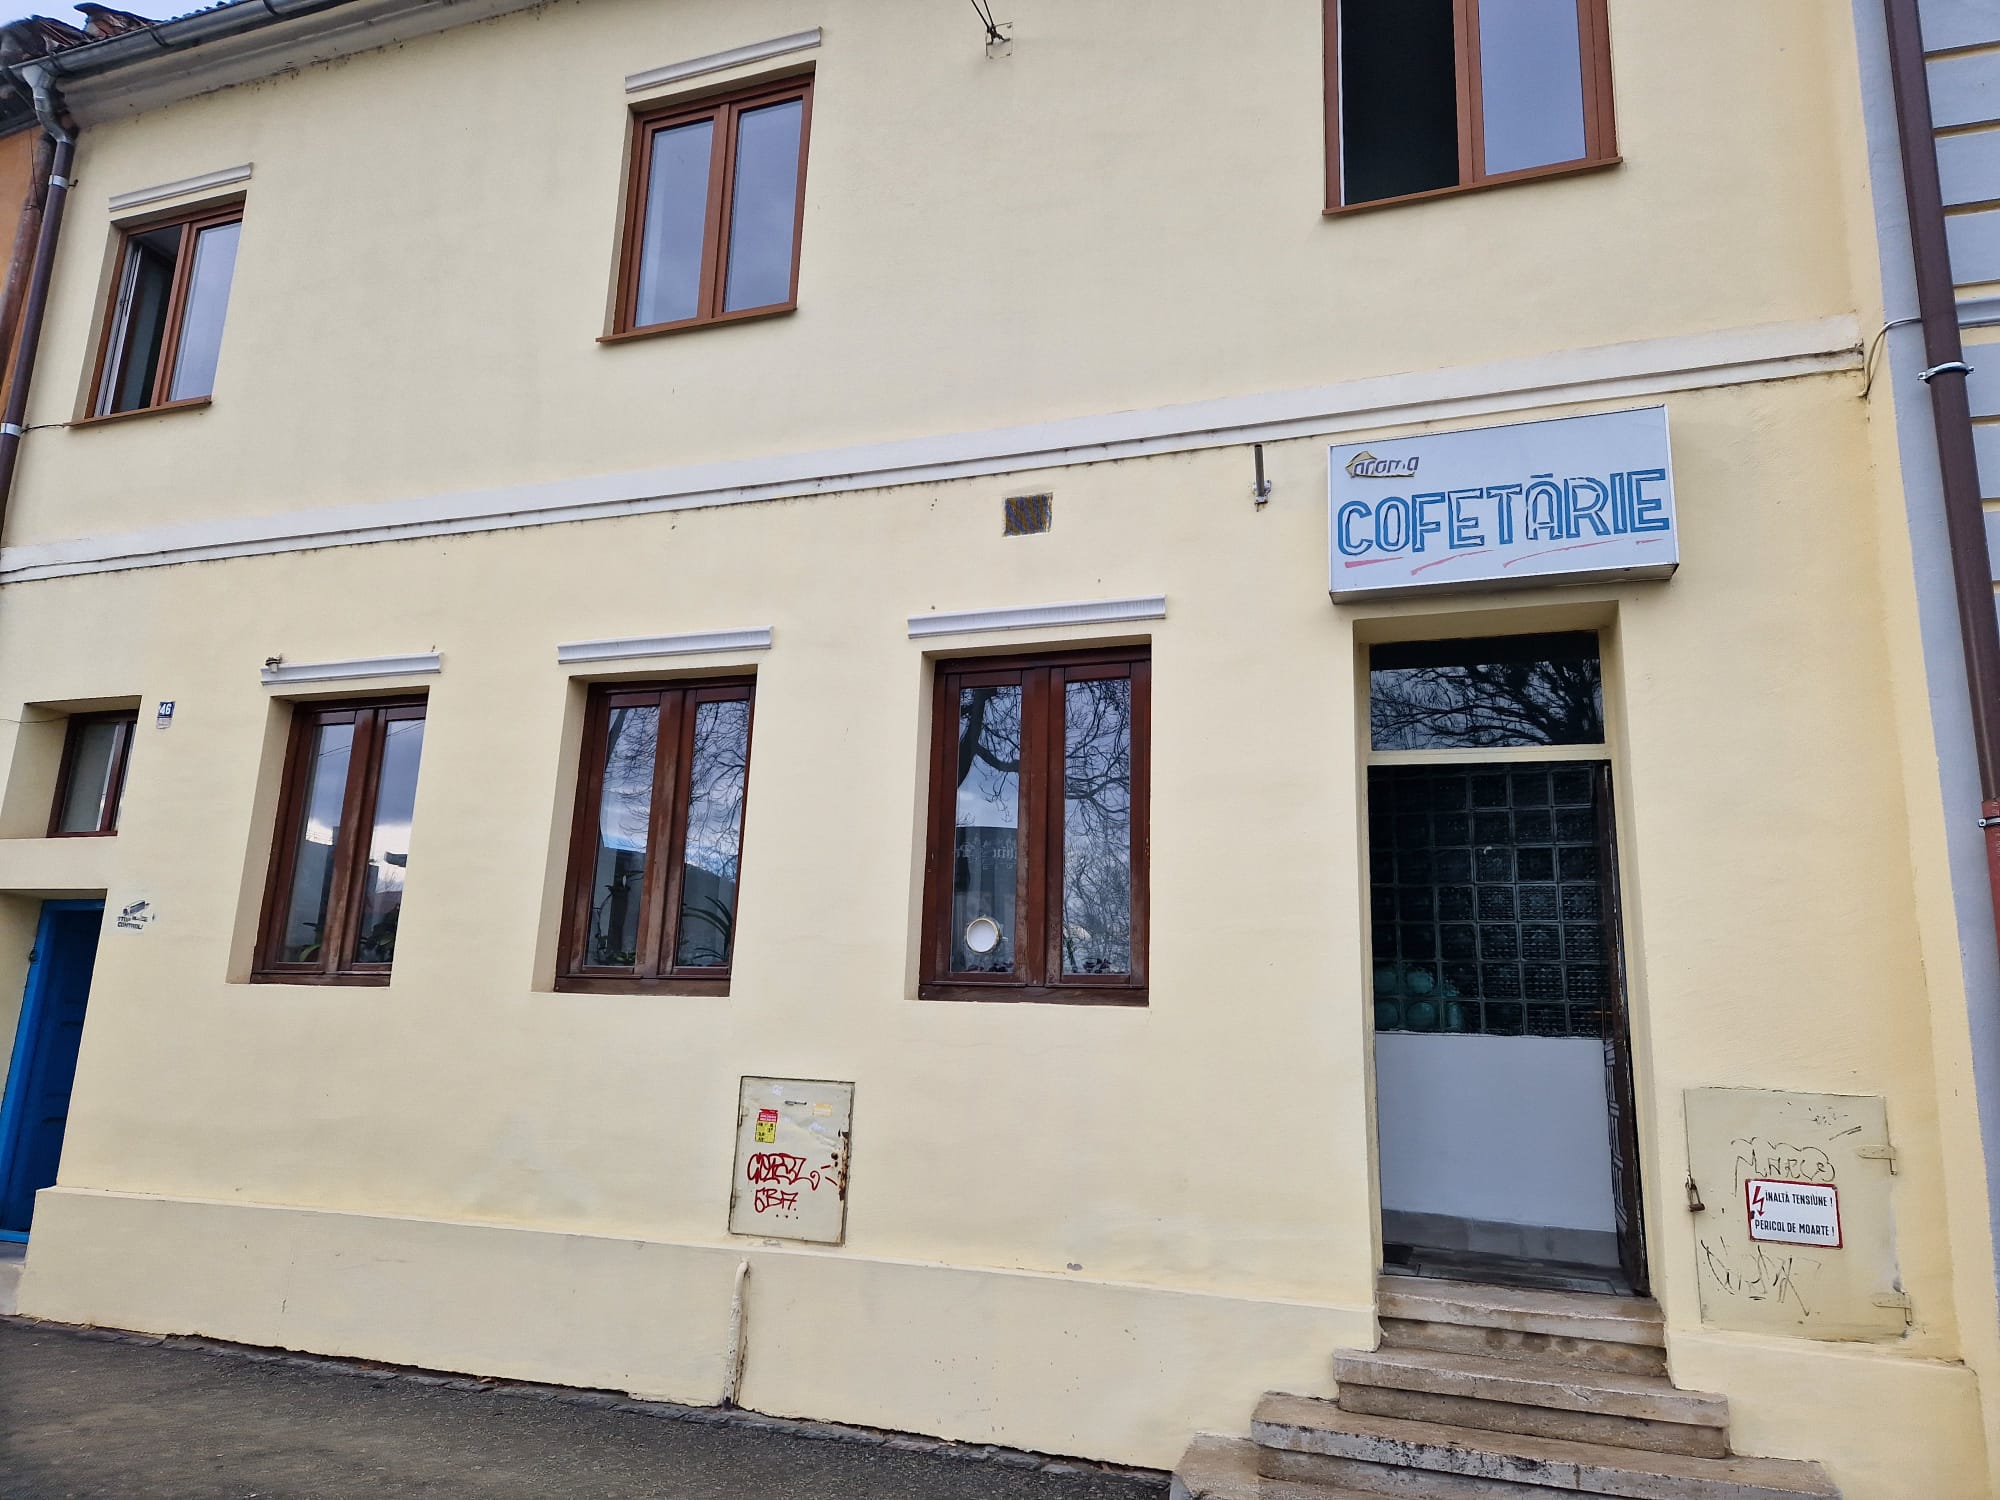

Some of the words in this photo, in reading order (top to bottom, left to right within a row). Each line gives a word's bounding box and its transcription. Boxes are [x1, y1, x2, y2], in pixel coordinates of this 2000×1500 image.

[160, 703, 172, 715] 46
[1754, 1219, 1786, 1232] PERICOL
[1787, 1222, 1796, 1233] DE
[1798, 1223, 1830, 1236] MOARTE
